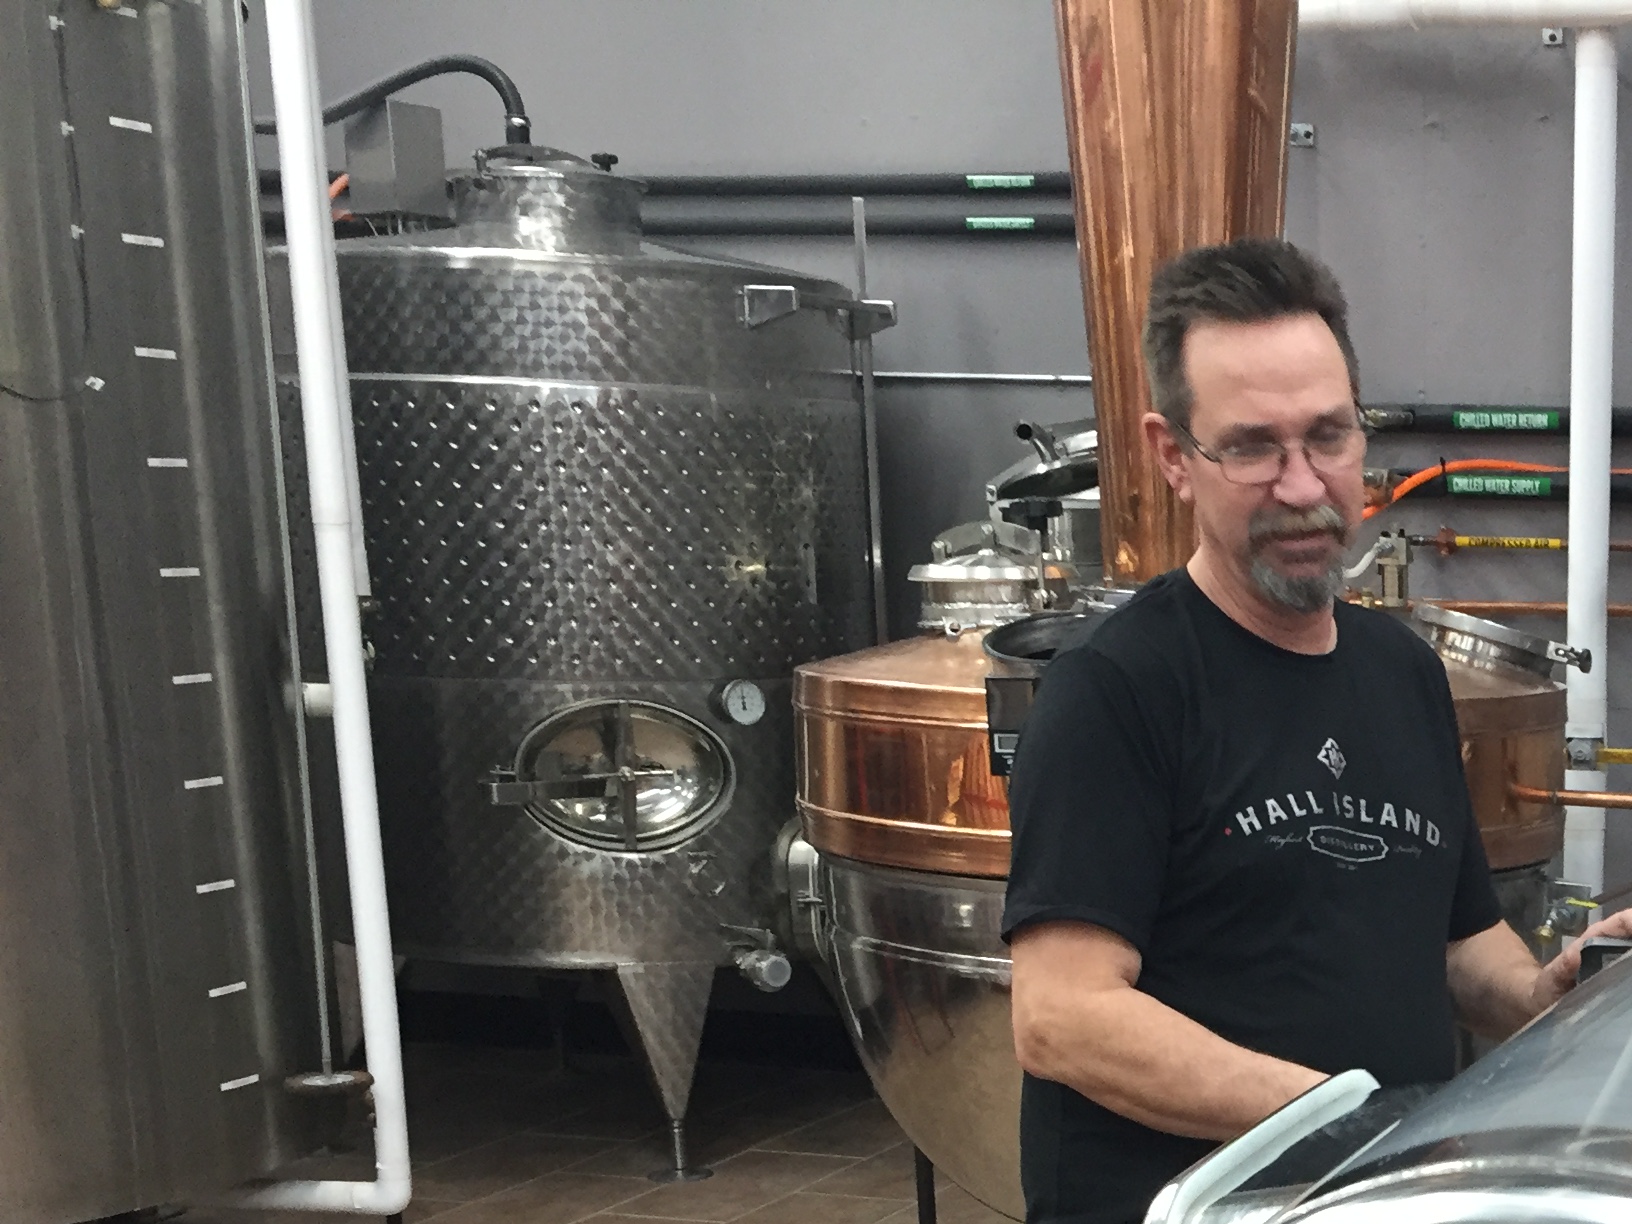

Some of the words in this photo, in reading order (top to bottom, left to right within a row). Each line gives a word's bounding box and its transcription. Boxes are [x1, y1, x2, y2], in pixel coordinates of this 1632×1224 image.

[1491, 413, 1517, 428] WATER
[1485, 478, 1510, 494] WATER
[1511, 479, 1540, 495] SUPPLY
[1468, 536, 1531, 548] COMPRESSED
[1534, 537, 1550, 549] AIR
[1235, 790, 1325, 836] HALL
[1332, 791, 1441, 847] ISLAND
